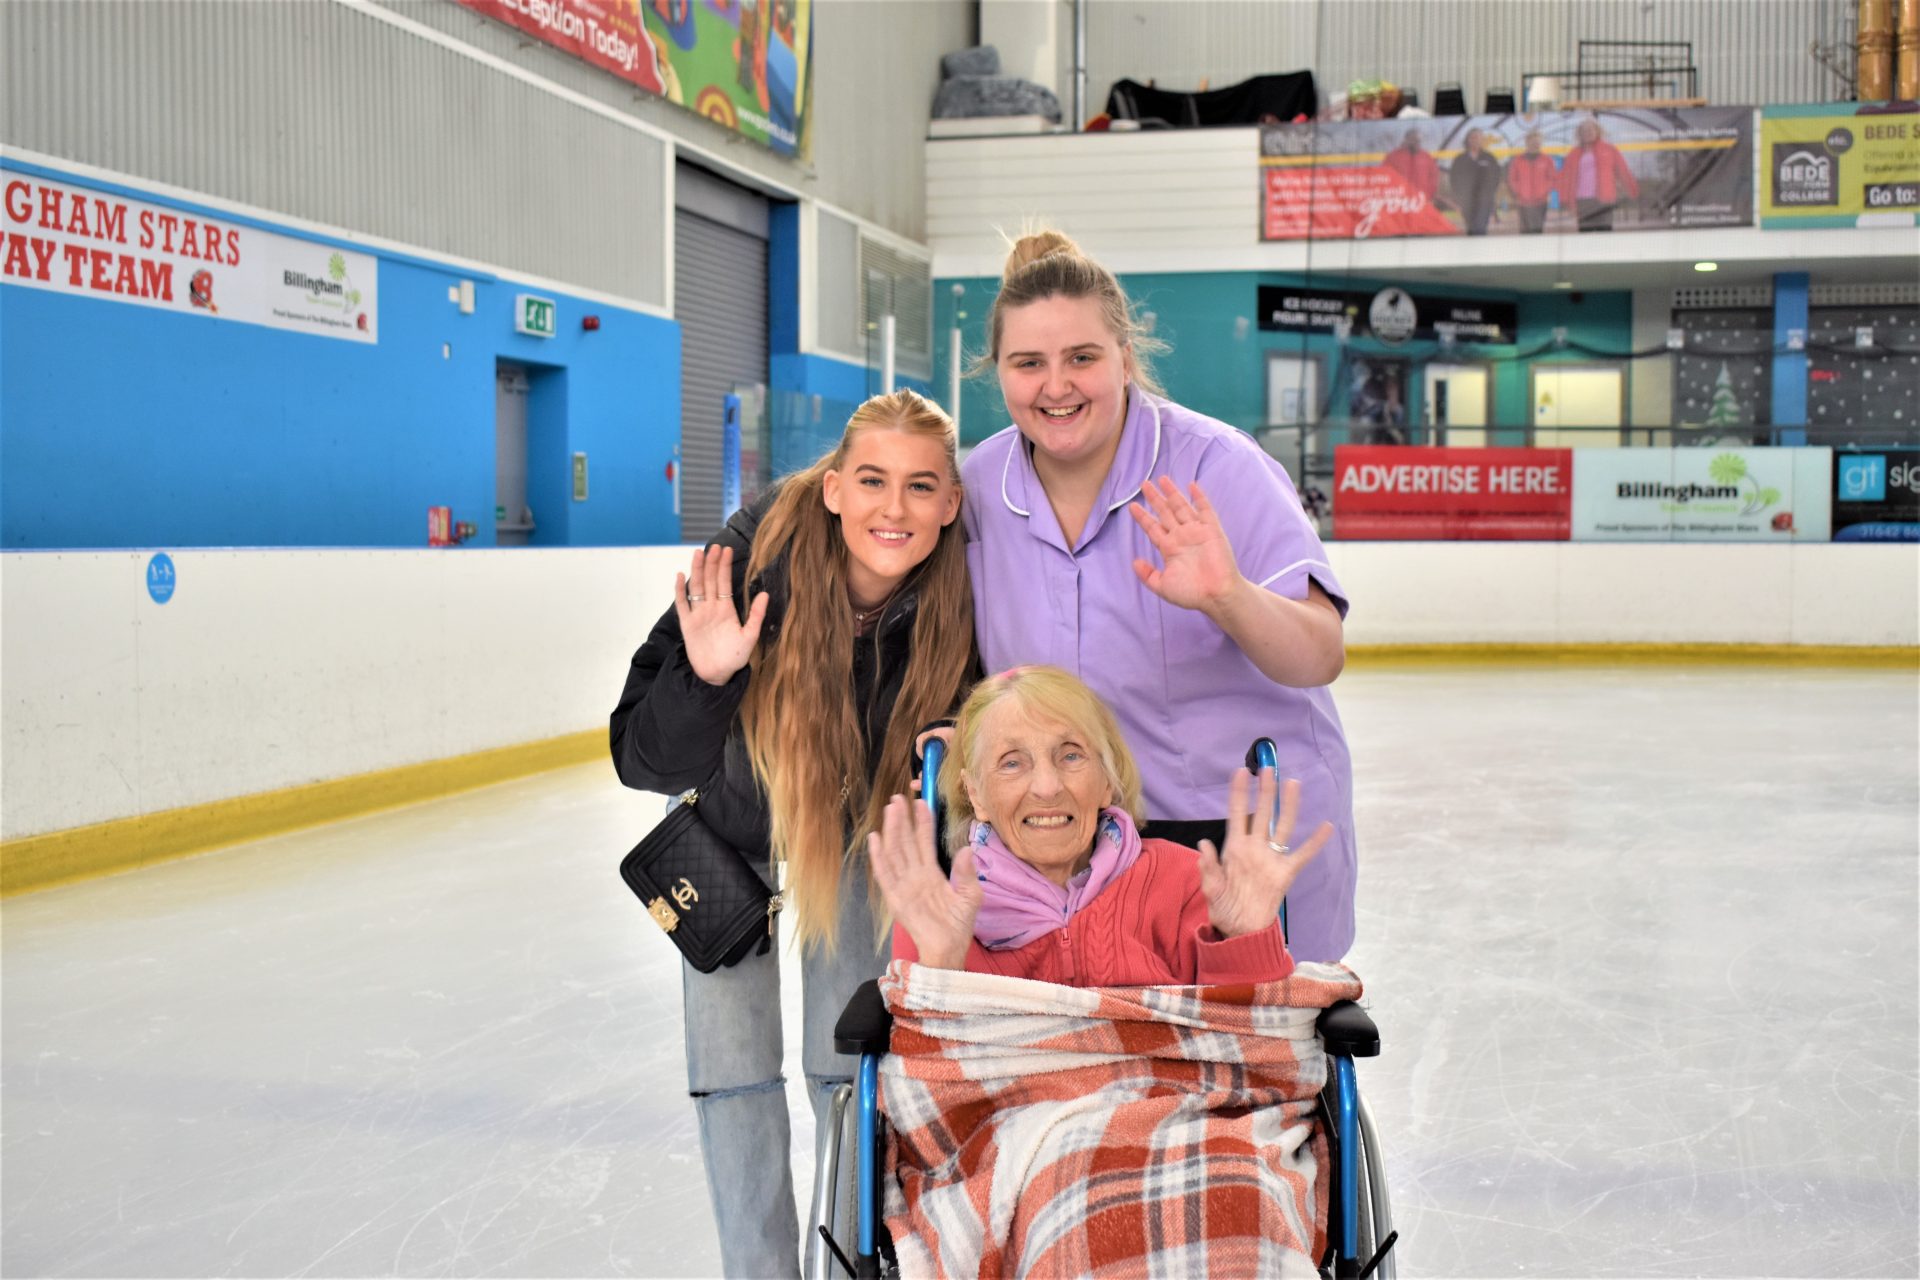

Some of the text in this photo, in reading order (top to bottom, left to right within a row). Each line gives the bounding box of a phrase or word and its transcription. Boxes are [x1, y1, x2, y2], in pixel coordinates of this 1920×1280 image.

[586, 18, 639, 71] Today!
[1865, 124, 1906, 139] BEDE
[1780, 164, 1829, 182] BEDE
[1780, 190, 1830, 202] COLLEGE
[1870, 185, 1917, 205] Go to:
[5, 180, 241, 266] GHAM STARS
[1354, 190, 1426, 239] grow
[0, 231, 174, 302] AY TEAM
[283, 269, 344, 296] Billingham
[1339, 464, 1567, 494] ADVERTISE HERE.
[1616, 481, 1739, 504] Billingham
[1845, 461, 1878, 496] gt
